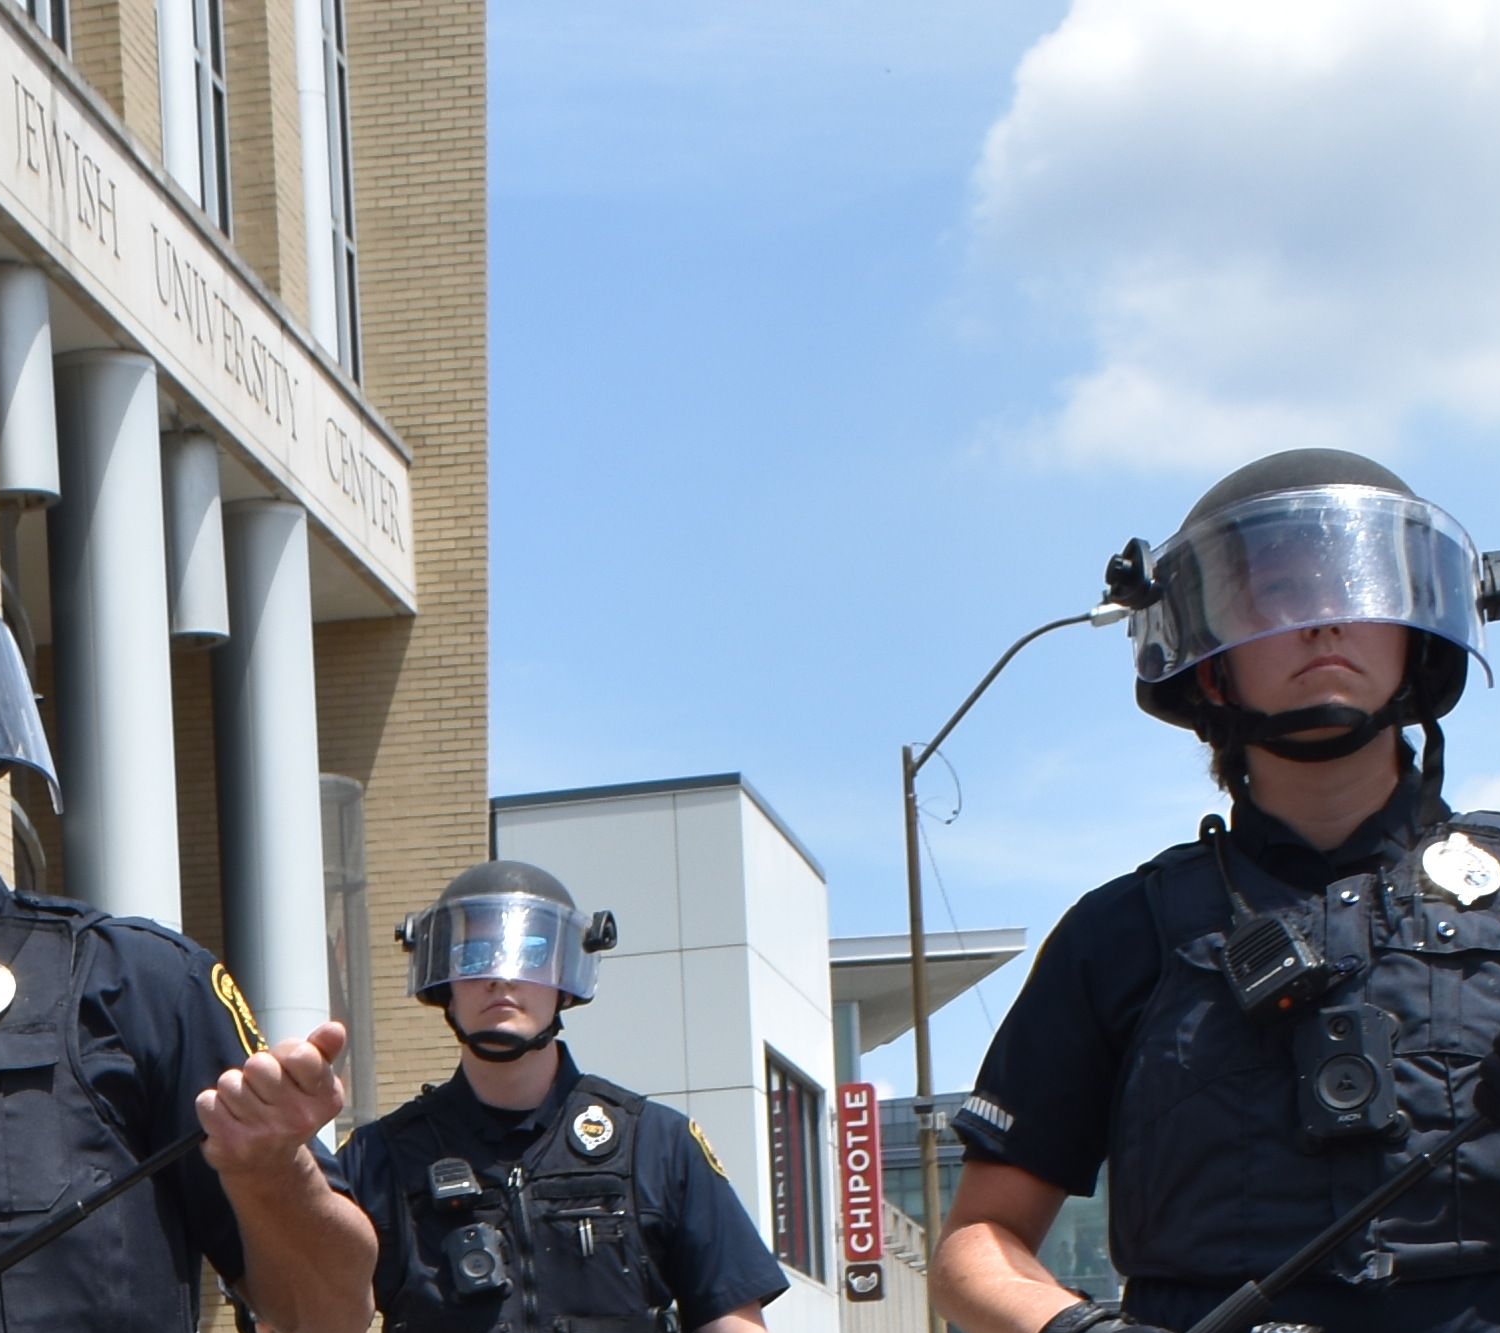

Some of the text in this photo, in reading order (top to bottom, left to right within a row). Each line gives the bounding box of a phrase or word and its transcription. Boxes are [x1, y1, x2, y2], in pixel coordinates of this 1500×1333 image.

[10, 75, 406, 553] JEWISH UNIVERSITY CENTER
[845, 1089, 874, 1253] CHIPOTLE
